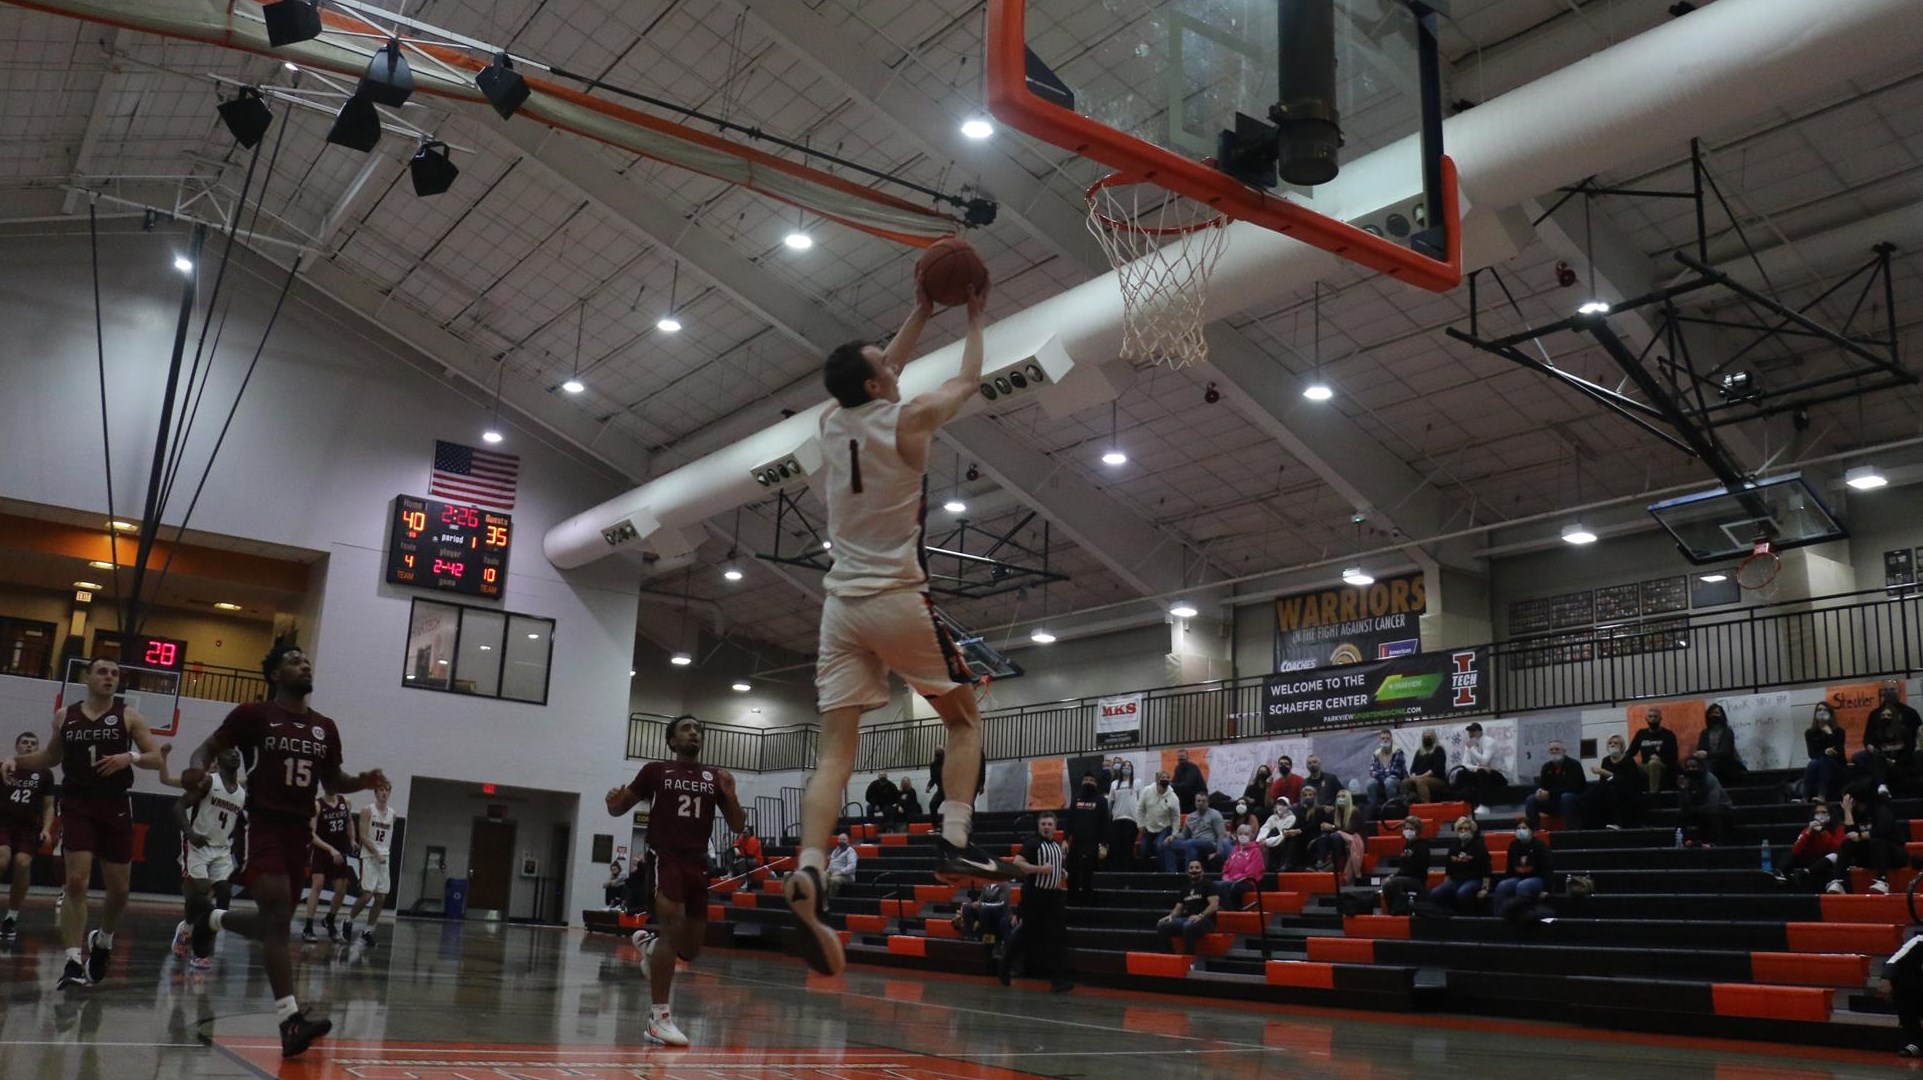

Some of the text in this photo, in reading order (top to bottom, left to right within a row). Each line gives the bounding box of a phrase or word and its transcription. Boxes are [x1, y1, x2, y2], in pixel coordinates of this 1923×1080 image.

[850, 439, 863, 494] 1
[403, 510, 425, 532] 40
[440, 504, 480, 528] 2:26
[441, 533, 465, 544] period
[471, 536, 478, 549] 1
[486, 525, 508, 547] 35
[404, 554, 414, 568] 4
[483, 567, 497, 584] 10
[1277, 575, 1426, 632] WARRIORS
[1317, 624, 1339, 640] FIGHT
[1341, 618, 1373, 636] AGAINST
[1375, 613, 1406, 631] CANCER
[145, 640, 177, 666] 28
[1270, 674, 1365, 697] WELCOME TO THE
[1452, 673, 1478, 687] TECH
[1102, 702, 1137, 717] MKS
[1269, 694, 1369, 715] SCHAEFER CENTER
[66, 728, 121, 741] RACERS
[88, 744, 98, 768] 1
[264, 736, 329, 759] RACERS
[283, 757, 314, 788] 15
[10, 789, 32, 804] 42
[664, 779, 716, 795] RACERS
[677, 795, 702, 819] 21
[218, 811, 229, 829] 4
[329, 820, 345, 832] 32
[375, 829, 386, 842] 12
